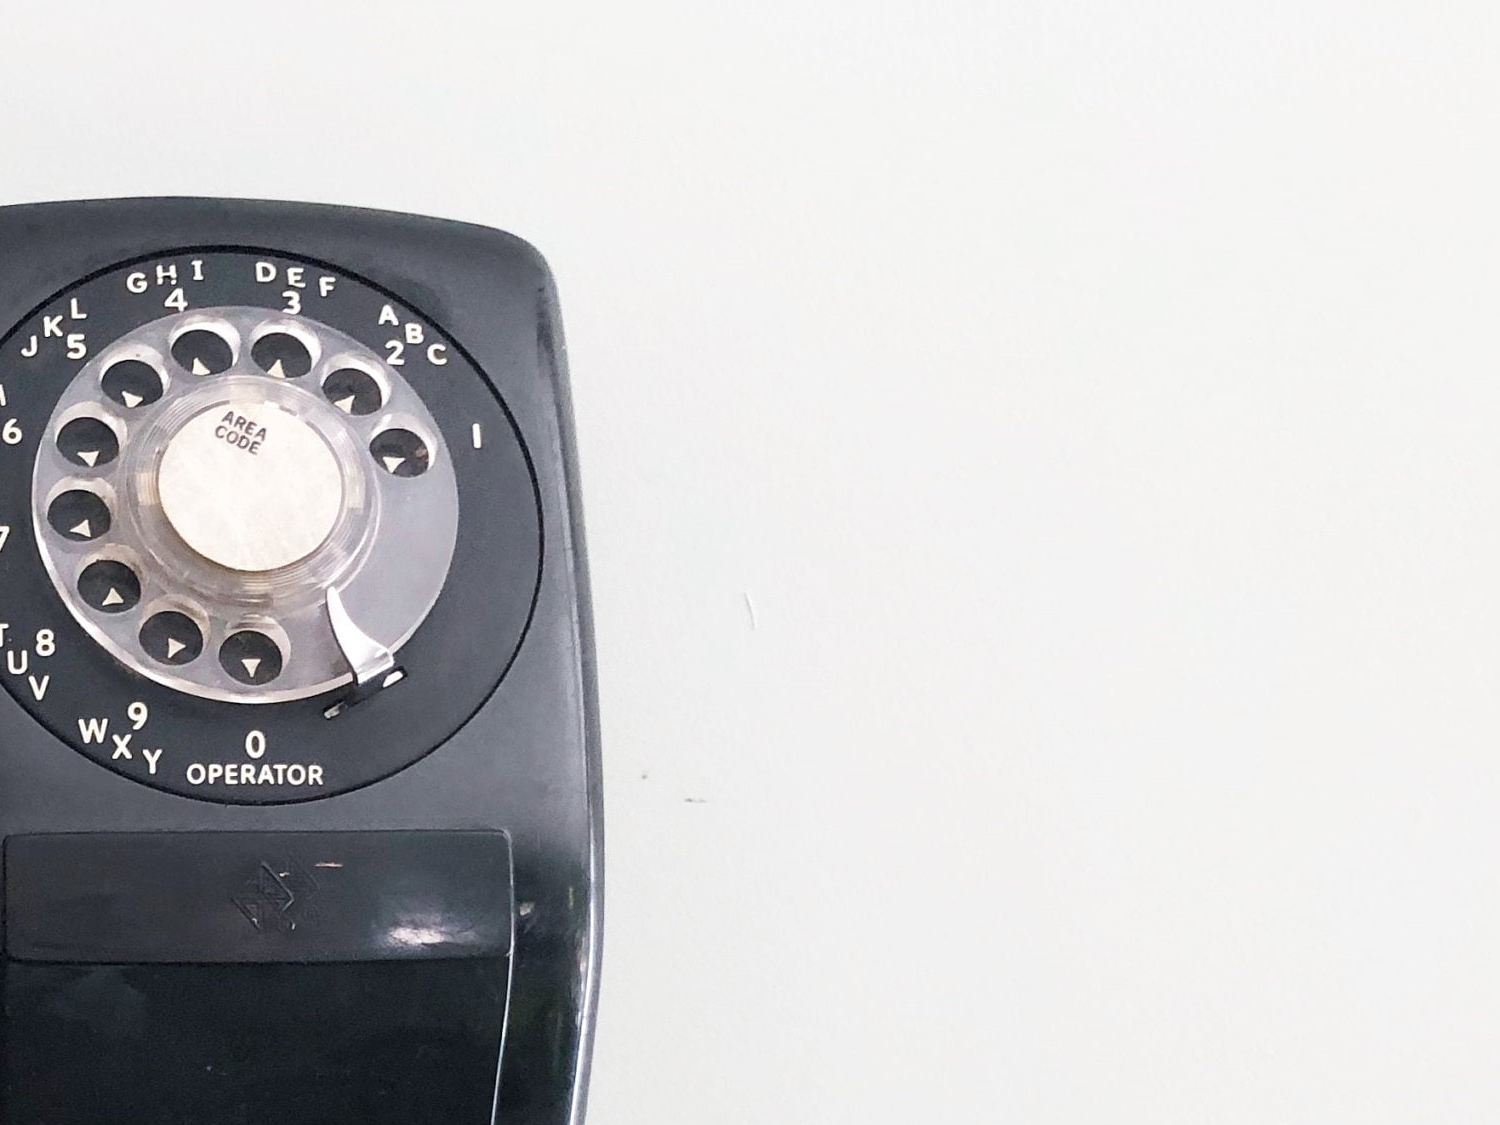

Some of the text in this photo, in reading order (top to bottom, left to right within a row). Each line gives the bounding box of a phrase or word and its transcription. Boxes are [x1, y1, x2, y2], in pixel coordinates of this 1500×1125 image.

[164, 289, 188, 312] 4
[282, 291, 302, 314] 3
[66, 333, 87, 360] 5
[386, 340, 405, 365] 2
[2, 418, 23, 445] 6
[221, 410, 267, 442] AREA
[215, 425, 262, 456] CODE
[35, 629, 56, 657] 8
[127, 701, 149, 730] 9
[186, 763, 324, 786] OPERATOR
